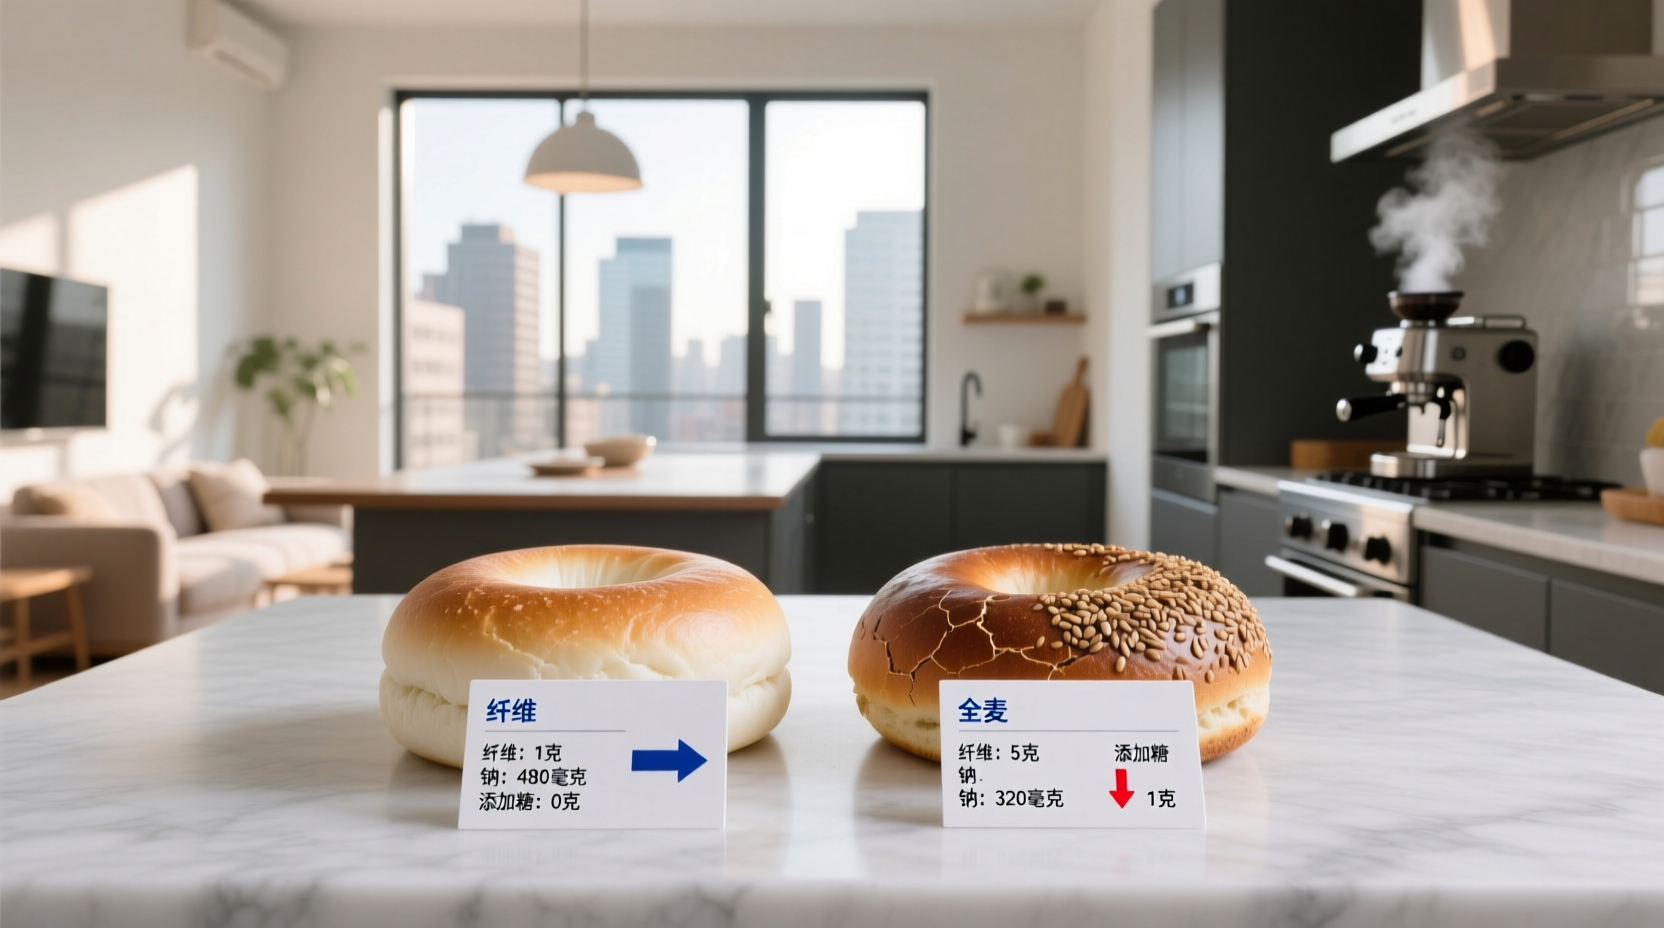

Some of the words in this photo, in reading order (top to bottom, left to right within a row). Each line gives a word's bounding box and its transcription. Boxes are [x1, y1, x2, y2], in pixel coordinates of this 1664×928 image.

[486, 697, 537, 724] 纤维
[958, 696, 1008, 723] 全麦
[1114, 743, 1169, 763] 添加糖
[1147, 788, 1176, 808] 1克
